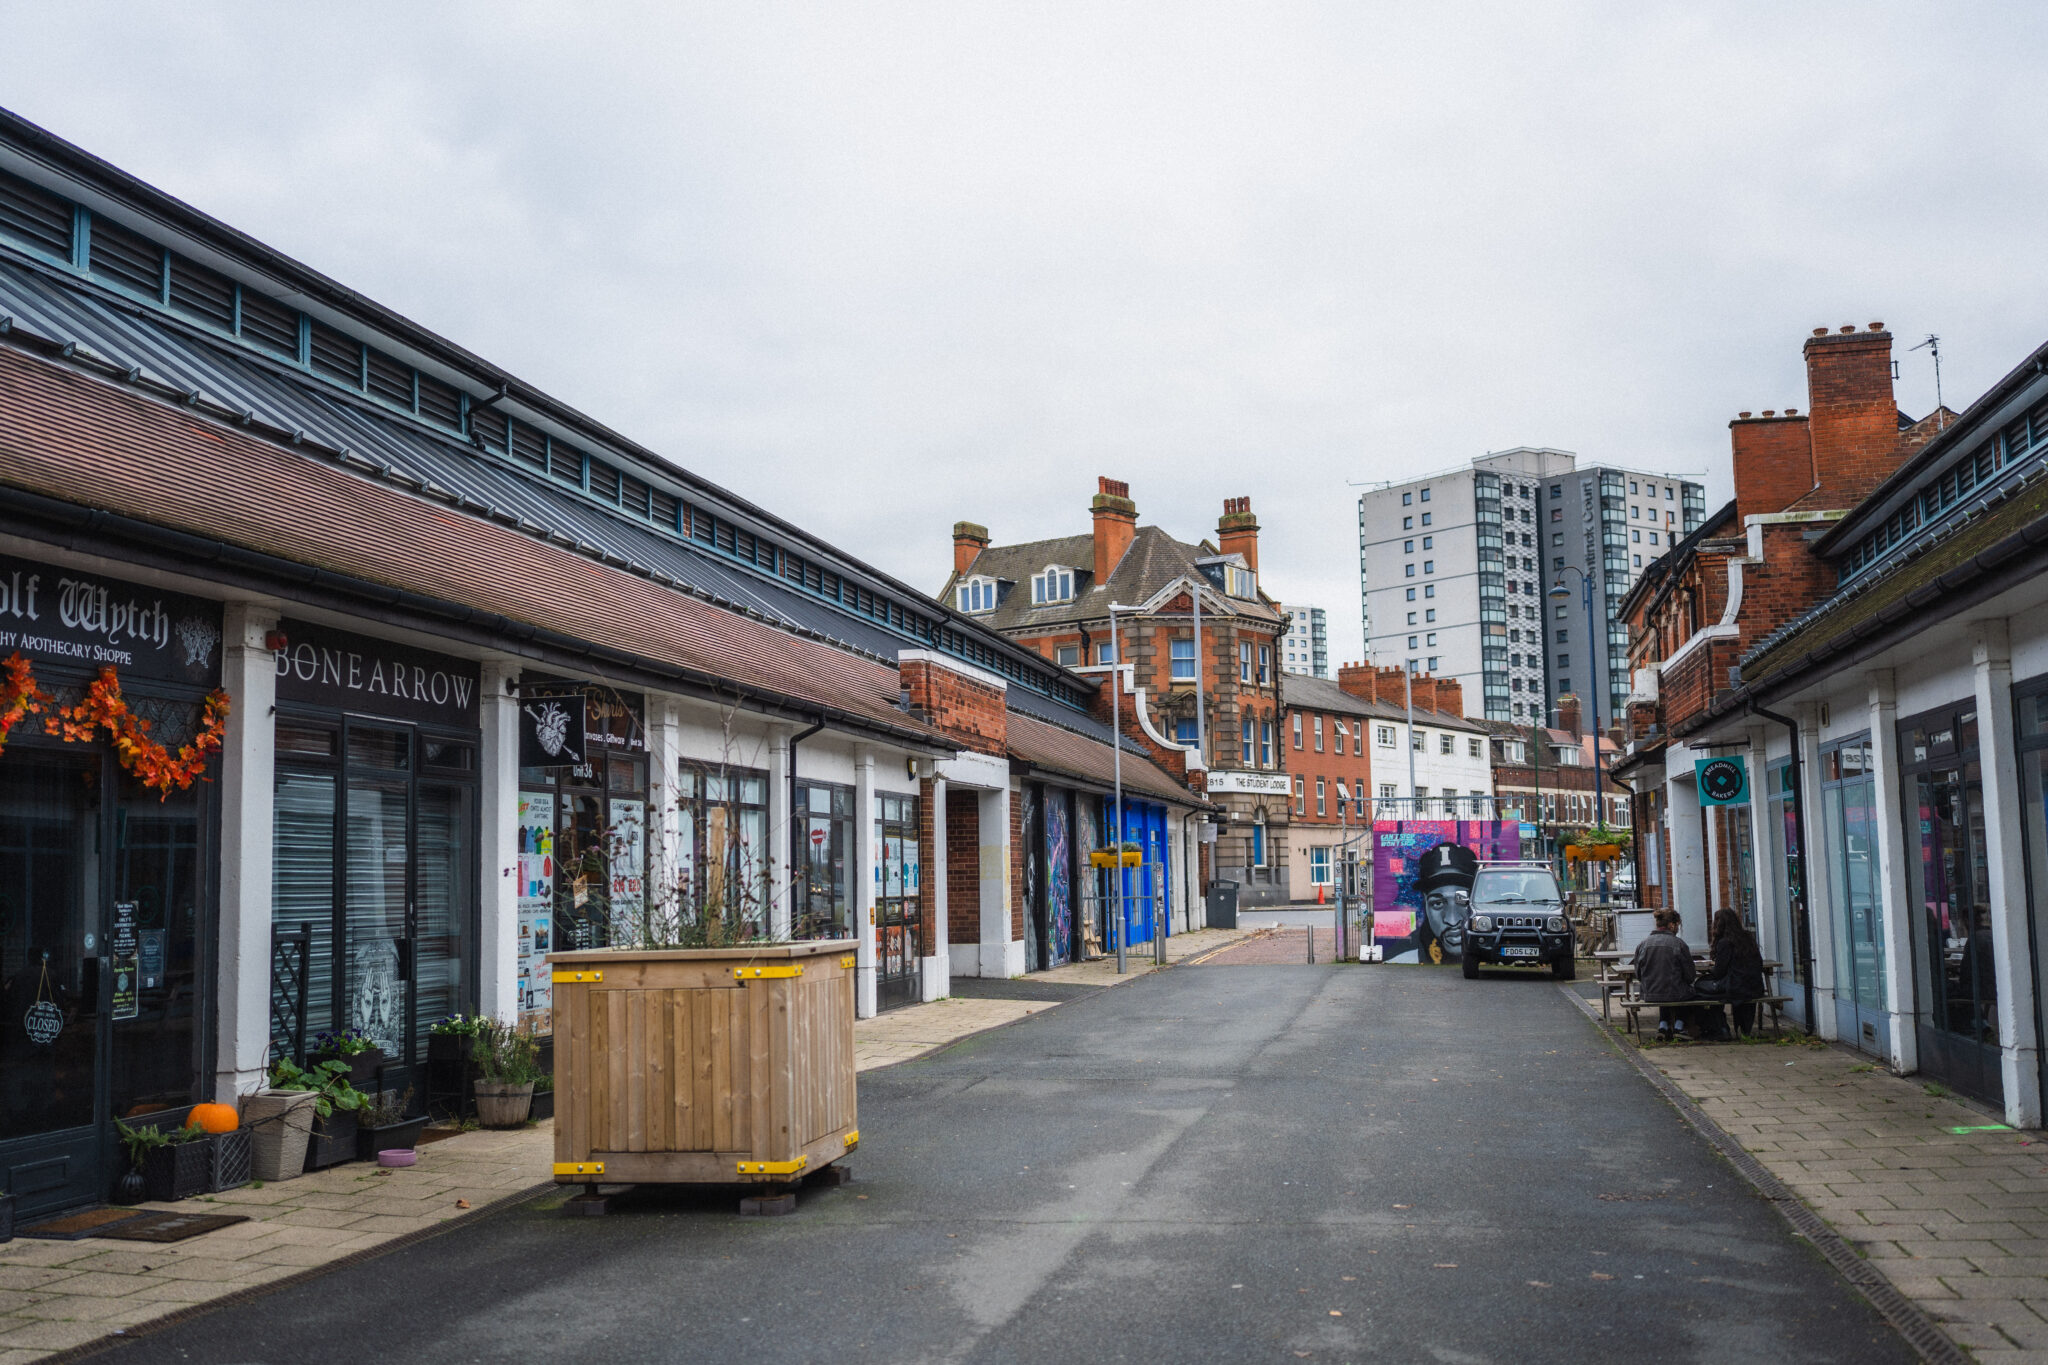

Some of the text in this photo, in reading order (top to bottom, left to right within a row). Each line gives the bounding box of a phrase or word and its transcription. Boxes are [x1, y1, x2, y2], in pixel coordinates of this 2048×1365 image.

[58, 577, 169, 650] Wytch
[21, 633, 91, 659] APOTHECARY
[93, 645, 132, 665] SHOPPE
[606, 733, 625, 745] Giftware
[573, 762, 593, 778] Unit 36
[1704, 763, 1736, 776] BREADMILL
[1236, 777, 1287, 790] THE STUDENT LODGE
[1711, 790, 1735, 799] BAKERY
[1439, 846, 1451, 866] I
[28, 1016, 60, 1032] CLOSED
